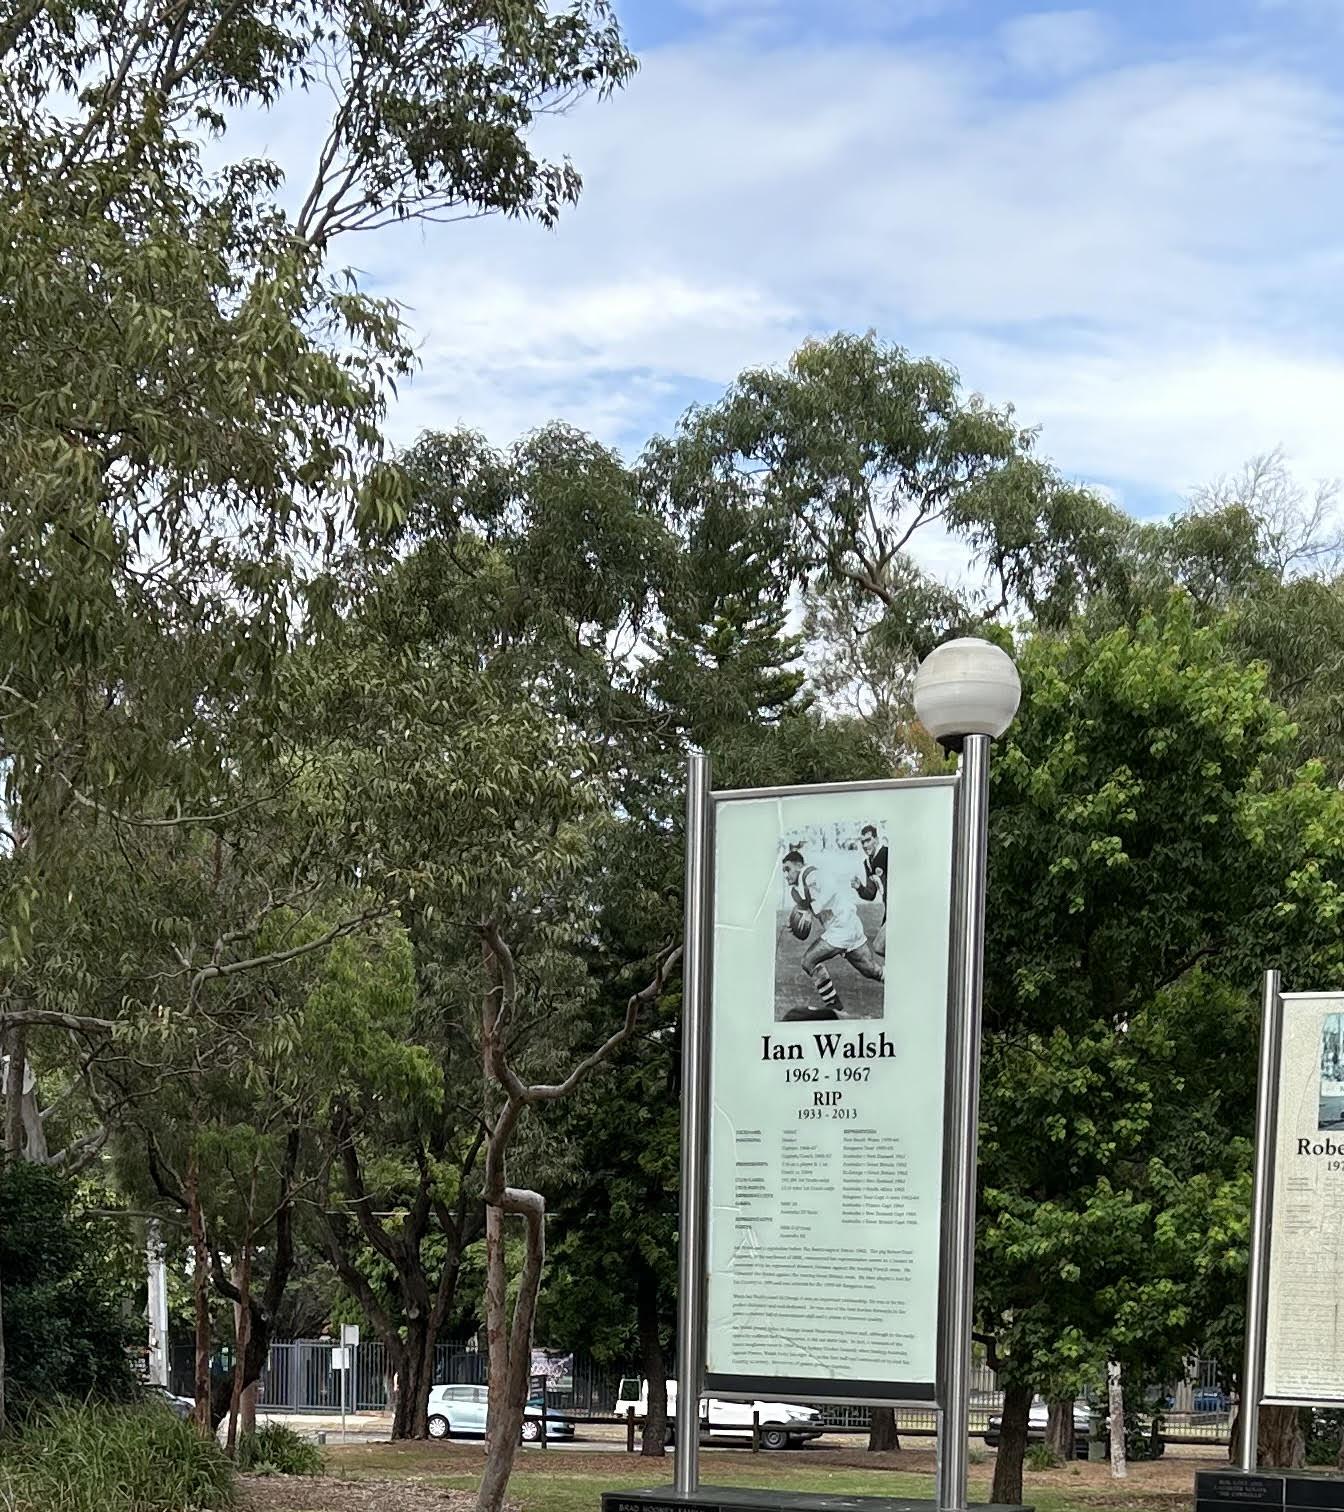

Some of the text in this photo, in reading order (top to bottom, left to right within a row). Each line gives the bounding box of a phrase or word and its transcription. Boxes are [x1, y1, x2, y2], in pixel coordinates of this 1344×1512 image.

[761, 1031, 897, 1062] Ian Walsh
[784, 1068, 820, 1083] 1962
[835, 1067, 871, 1082] 1967
[813, 1091, 843, 1107] RIP
[797, 1108, 822, 1120] 1933
[832, 1108, 858, 1120] 2013
